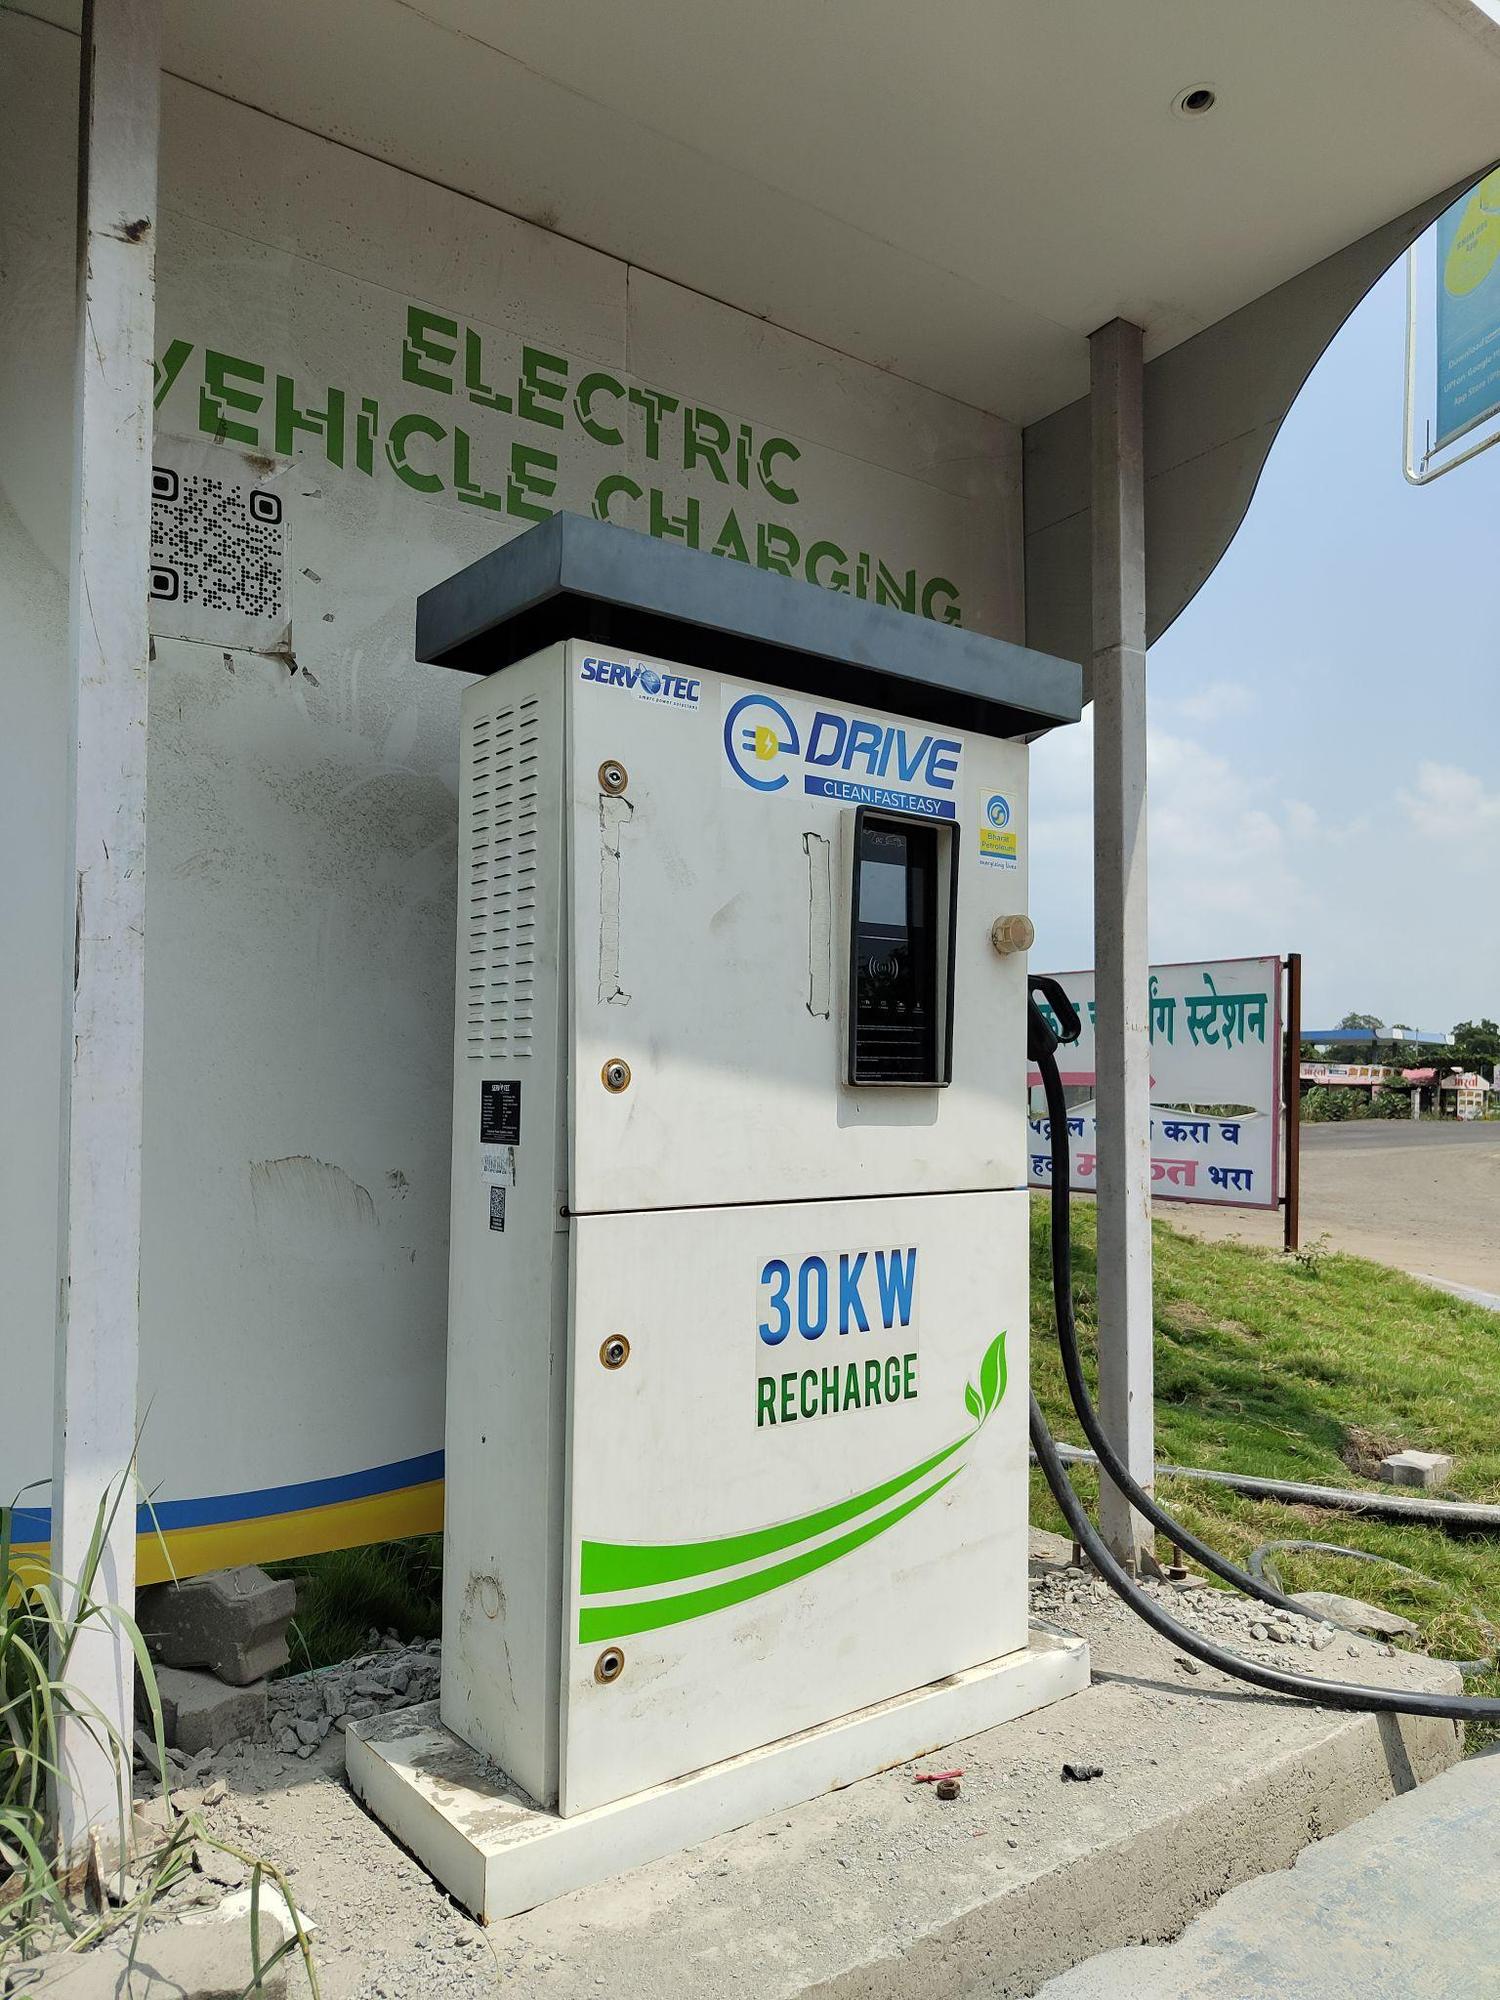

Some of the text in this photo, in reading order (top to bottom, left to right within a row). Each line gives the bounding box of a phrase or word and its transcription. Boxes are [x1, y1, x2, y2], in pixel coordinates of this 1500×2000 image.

[401, 306, 801, 506] ELECTRIC
[581, 658, 700, 702] SERVOTEC
[805, 711, 963, 790] DRIVE
[981, 841, 1017, 852] Petroleum
[987, 832, 1010, 843] Bharat
[1184, 973, 1268, 1050] स्टेशन
[1162, 1120, 1210, 1144] करा
[1219, 1123, 1241, 1145] व
[1208, 1165, 1254, 1192] भरा
[758, 1247, 917, 1346] 30KW
[757, 1353, 918, 1428] RECHARGE
